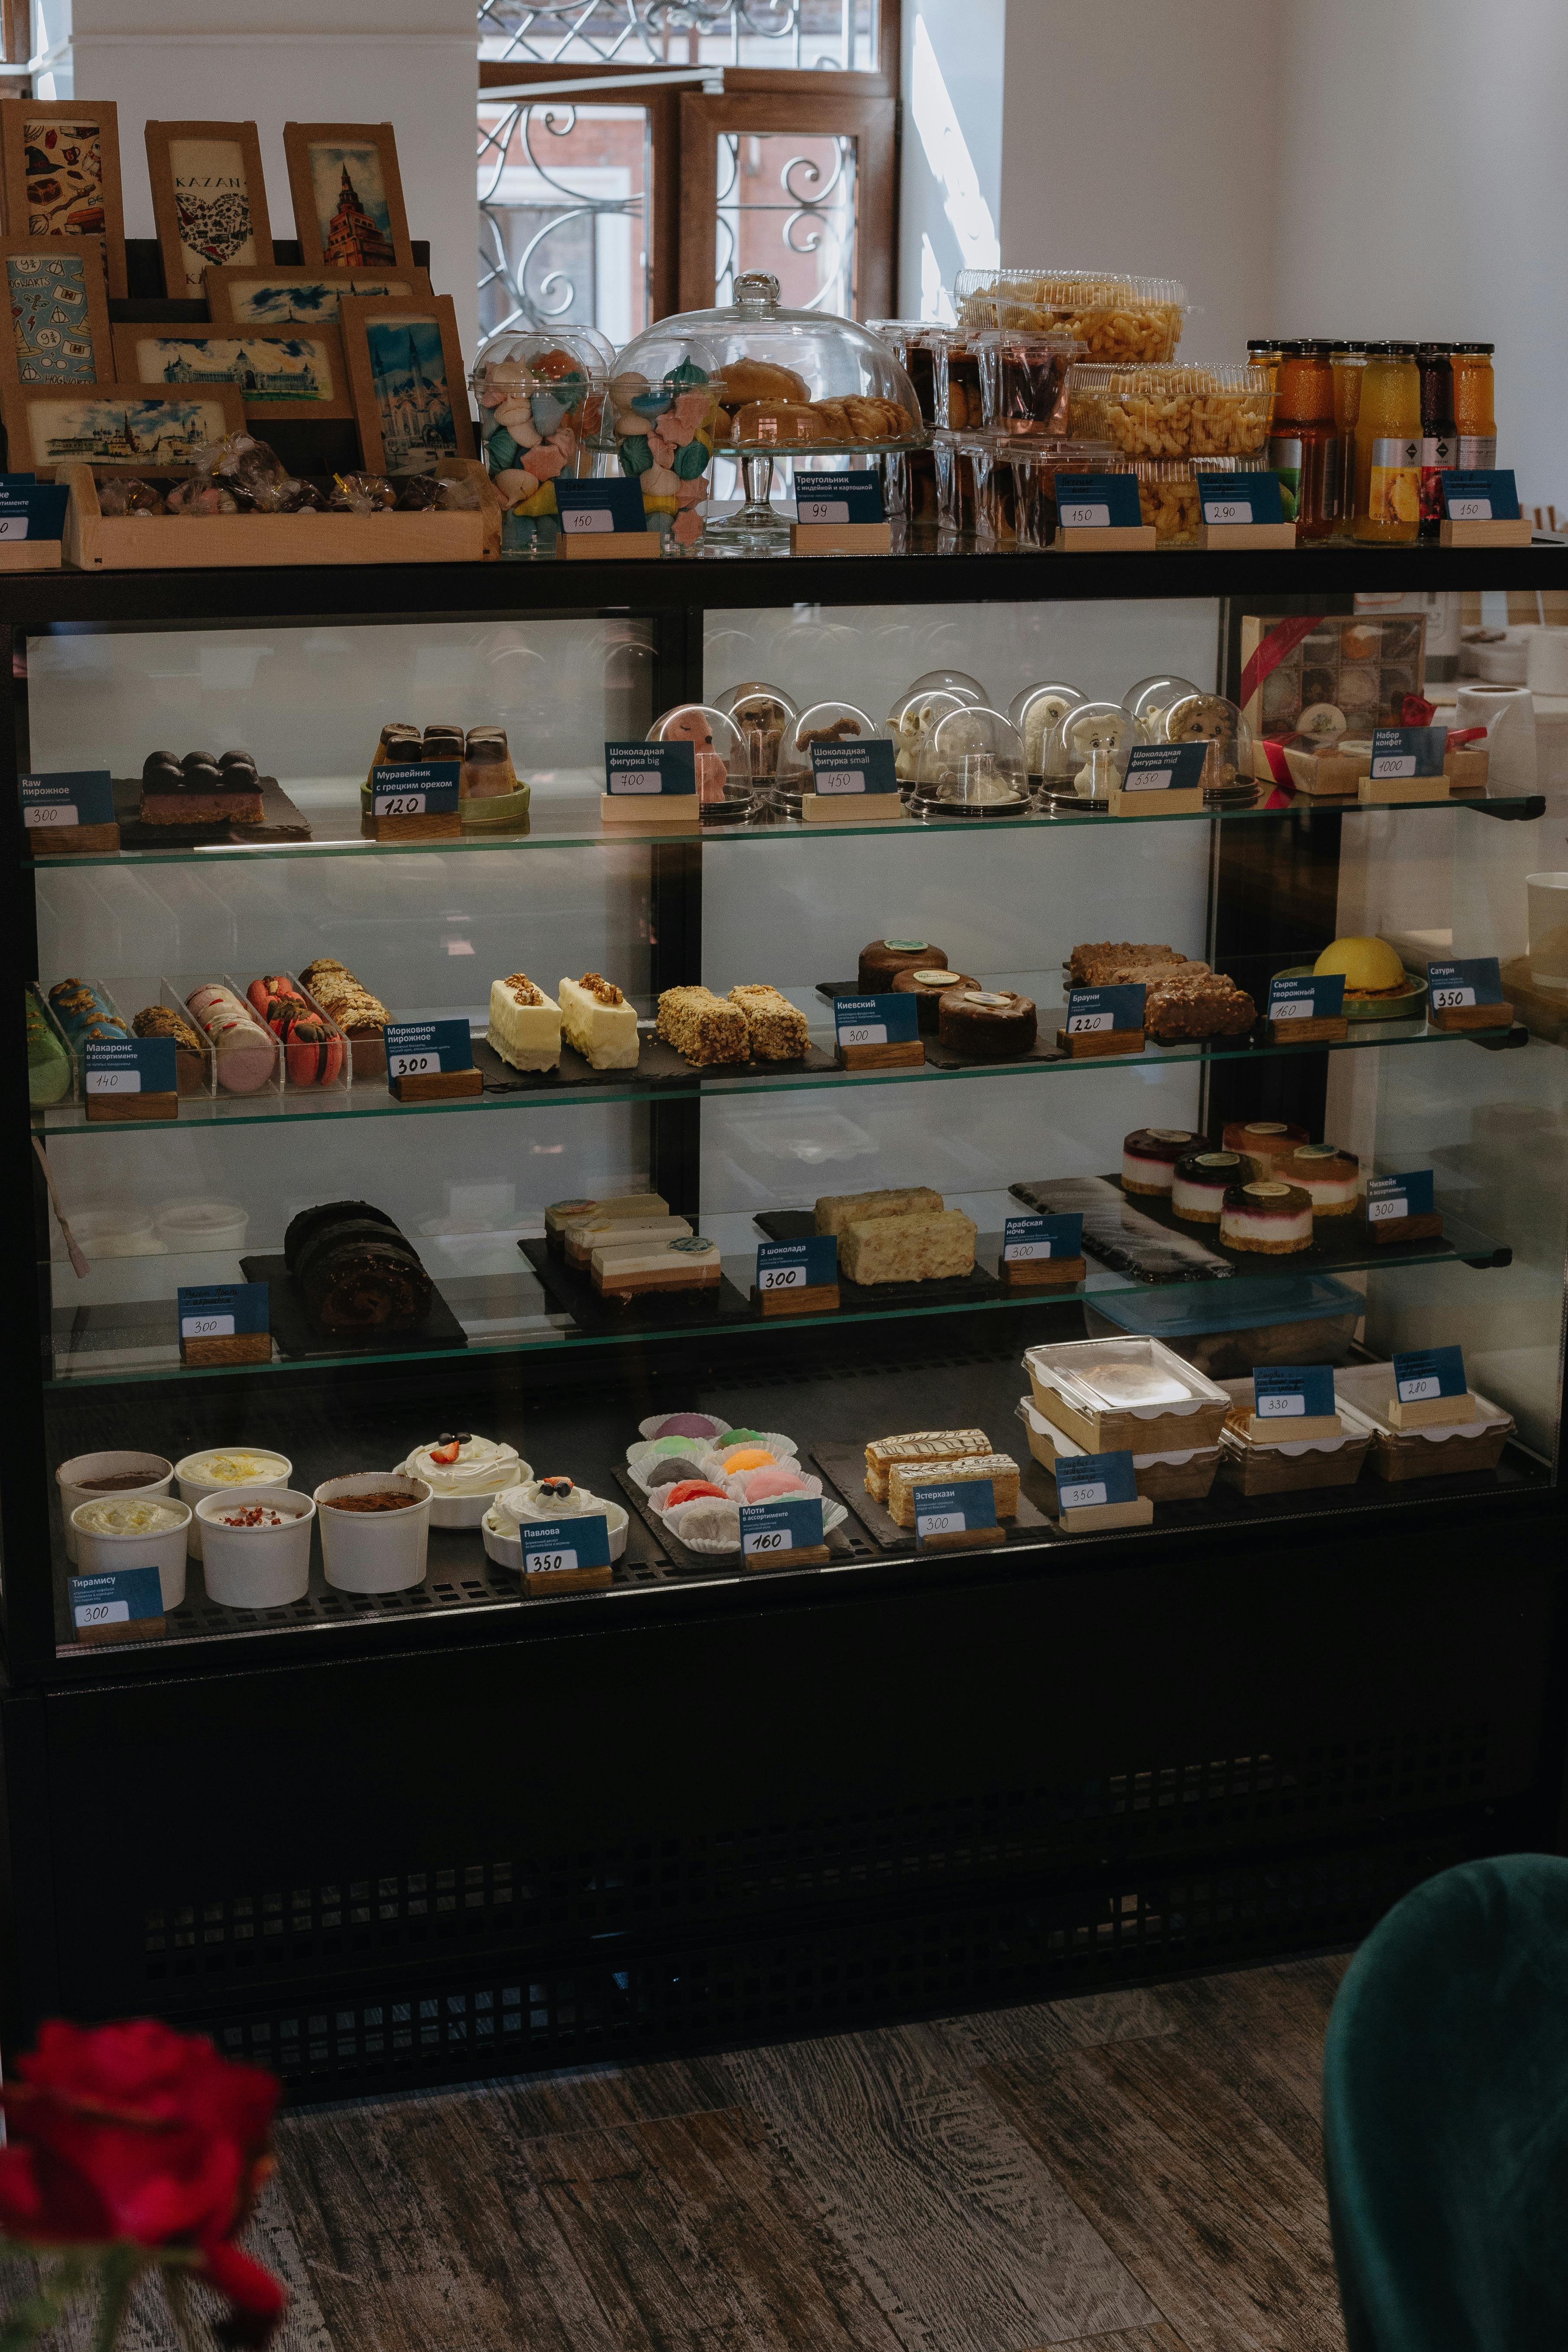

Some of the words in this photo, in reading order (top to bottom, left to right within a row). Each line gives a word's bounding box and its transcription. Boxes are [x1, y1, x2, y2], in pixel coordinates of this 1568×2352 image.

[175, 178, 240, 188] KAZAN
[9, 276, 51, 289] OGWARTS
[796, 476, 849, 484] Треугольник
[813, 504, 828, 517] 99
[1072, 509, 1092, 521] 150
[1214, 506, 1235, 518] 290
[1460, 504, 1479, 515] 150
[573, 516, 592, 527] 150
[1376, 731, 1399, 740] Набор
[1376, 739, 1402, 747] конфет
[610, 748, 665, 756] Шоколадная
[814, 748, 866, 756] Шоколадная
[610, 757, 645, 766] фигурка
[647, 757, 659, 766] big
[815, 758, 848, 766] фигурка
[850, 756, 870, 764] small
[1131, 759, 1162, 767] фигурка
[1379, 760, 1403, 772] 1000
[377, 769, 431, 780] Муравейник
[621, 774, 644, 786] 700
[1135, 773, 1159, 785] 550
[828, 773, 851, 788] 450
[23, 787, 69, 796] пирожное
[383, 783, 419, 792] грецким
[420, 781, 452, 789] орехом
[385, 798, 419, 815] 120
[33, 809, 57, 823] 300
[1073, 994, 1100, 1002] Брауни
[1273, 988, 1315, 998] творожный
[838, 999, 876, 1009] Киевский
[1438, 992, 1463, 1006] 350
[1276, 1005, 1296, 1018] 160
[387, 1025, 435, 1036] Морковное
[1075, 1018, 1101, 1032] 220
[388, 1034, 431, 1044] пирожное
[850, 1030, 868, 1042] 300
[86, 1044, 133, 1053] Макаронс
[399, 1058, 428, 1075] 300
[96, 1075, 118, 1087] 140
[1370, 1178, 1397, 1187] Чизкейк
[1373, 1187, 1406, 1195] ассортименте
[1375, 1203, 1394, 1217] 300
[1006, 1220, 1043, 1229] Арабская
[767, 1245, 806, 1255] шоколада
[1012, 1246, 1033, 1258] 300
[766, 1271, 796, 1288] 300
[195, 1321, 217, 1333] 300
[1409, 1382, 1426, 1394] 280
[1268, 1400, 1288, 1410] 330
[915, 1491, 955, 1500] Эстерхази
[1073, 1489, 1094, 1501] 350
[747, 1512, 788, 1521] ассортименте
[927, 1518, 948, 1530] 300
[524, 1528, 560, 1538] Павлова
[752, 1534, 781, 1550] 160
[533, 1555, 562, 1572] 350
[72, 1577, 116, 1588] Тирамису
[84, 1606, 108, 1622] 300
